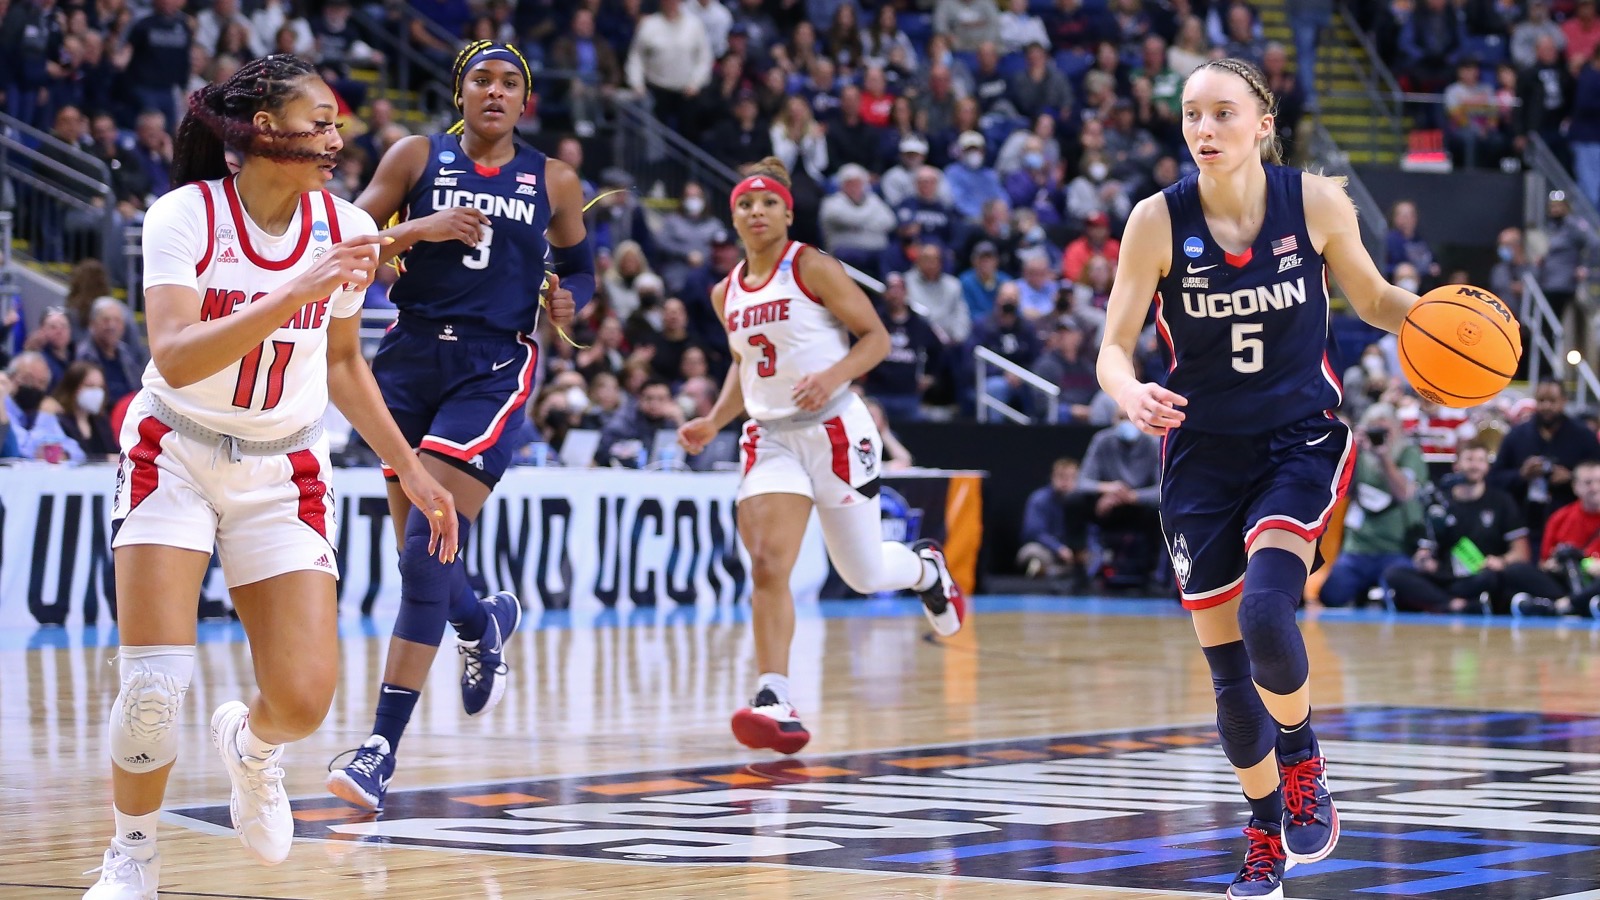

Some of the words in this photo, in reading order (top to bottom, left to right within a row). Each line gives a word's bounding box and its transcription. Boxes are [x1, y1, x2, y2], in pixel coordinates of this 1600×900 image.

[432, 189, 536, 225] UCONN
[462, 223, 494, 270] 3
[1186, 245, 1204, 253] NCAA
[1278, 257, 1304, 271] EAST
[1280, 253, 1298, 263] BIG
[200, 288, 246, 322] NC
[742, 299, 792, 329] STATE
[1182, 276, 1307, 318] UCONN
[1456, 287, 1511, 323] NCAA
[748, 333, 777, 378] 3
[1231, 322, 1264, 374] 5
[232, 339, 295, 411] 11
[313, 561, 333, 569] adidas
[123, 756, 156, 764] adidas
